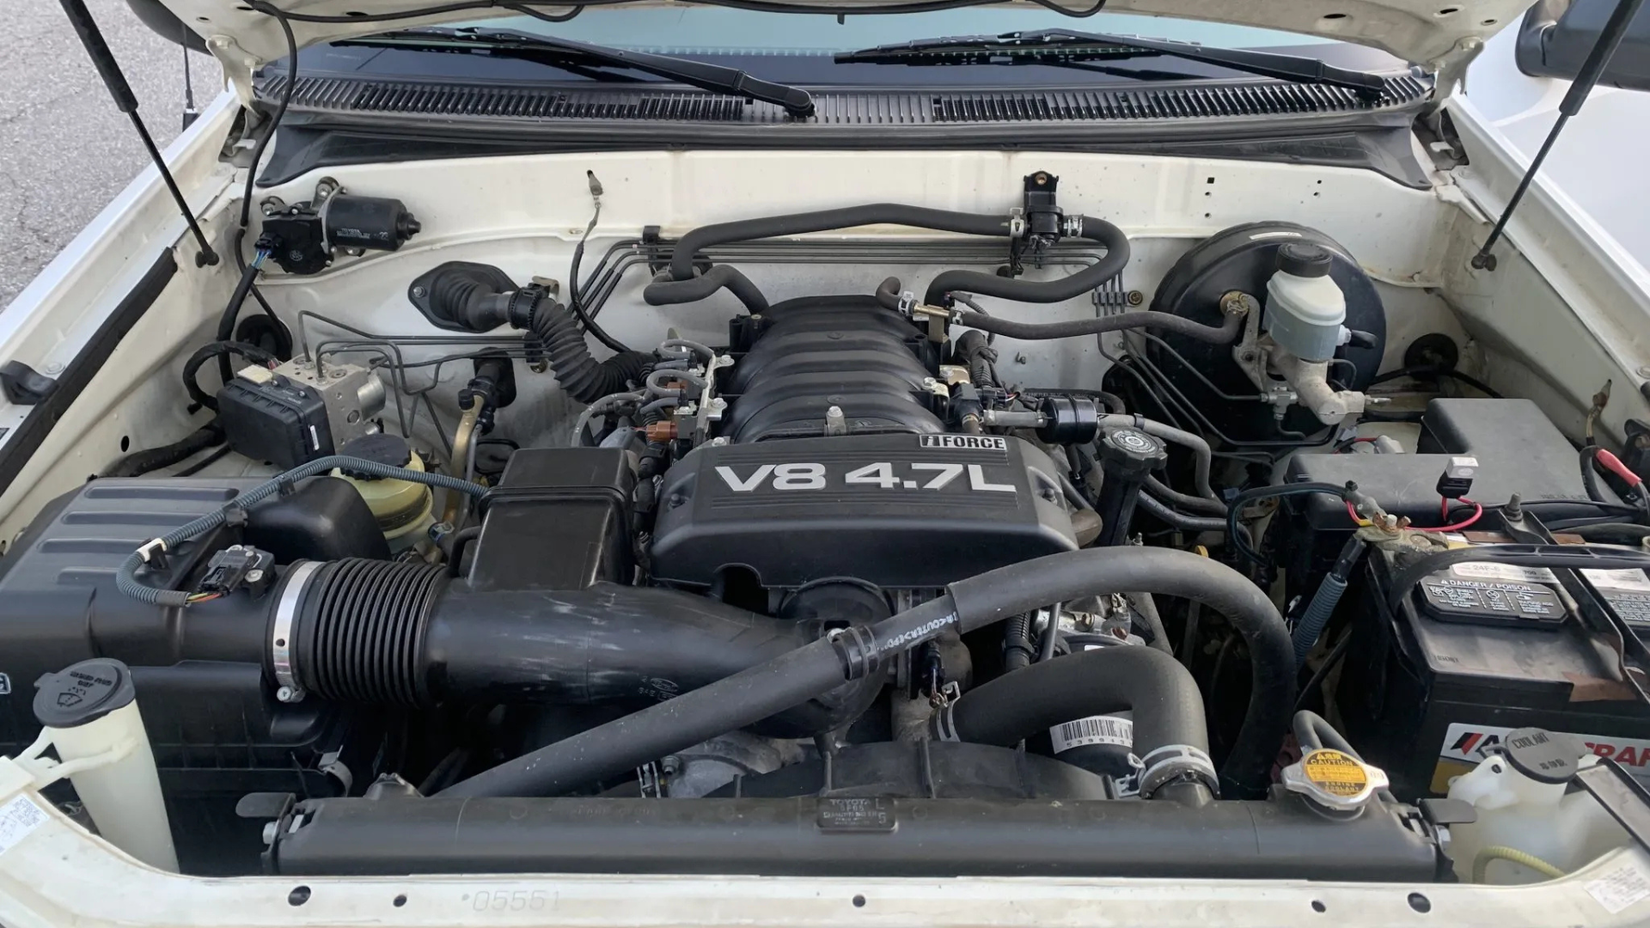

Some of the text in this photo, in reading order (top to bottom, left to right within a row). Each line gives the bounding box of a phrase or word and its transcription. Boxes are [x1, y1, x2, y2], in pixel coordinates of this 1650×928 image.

[715, 462, 1016, 492] V8 4.7L
[1449, 579, 1488, 589] DANGER
[1495, 583, 1531, 591] POISON
[1511, 732, 1550, 749] COOLANT
[1310, 759, 1354, 767] CAUTION
[472, 890, 560, 912] 05551
